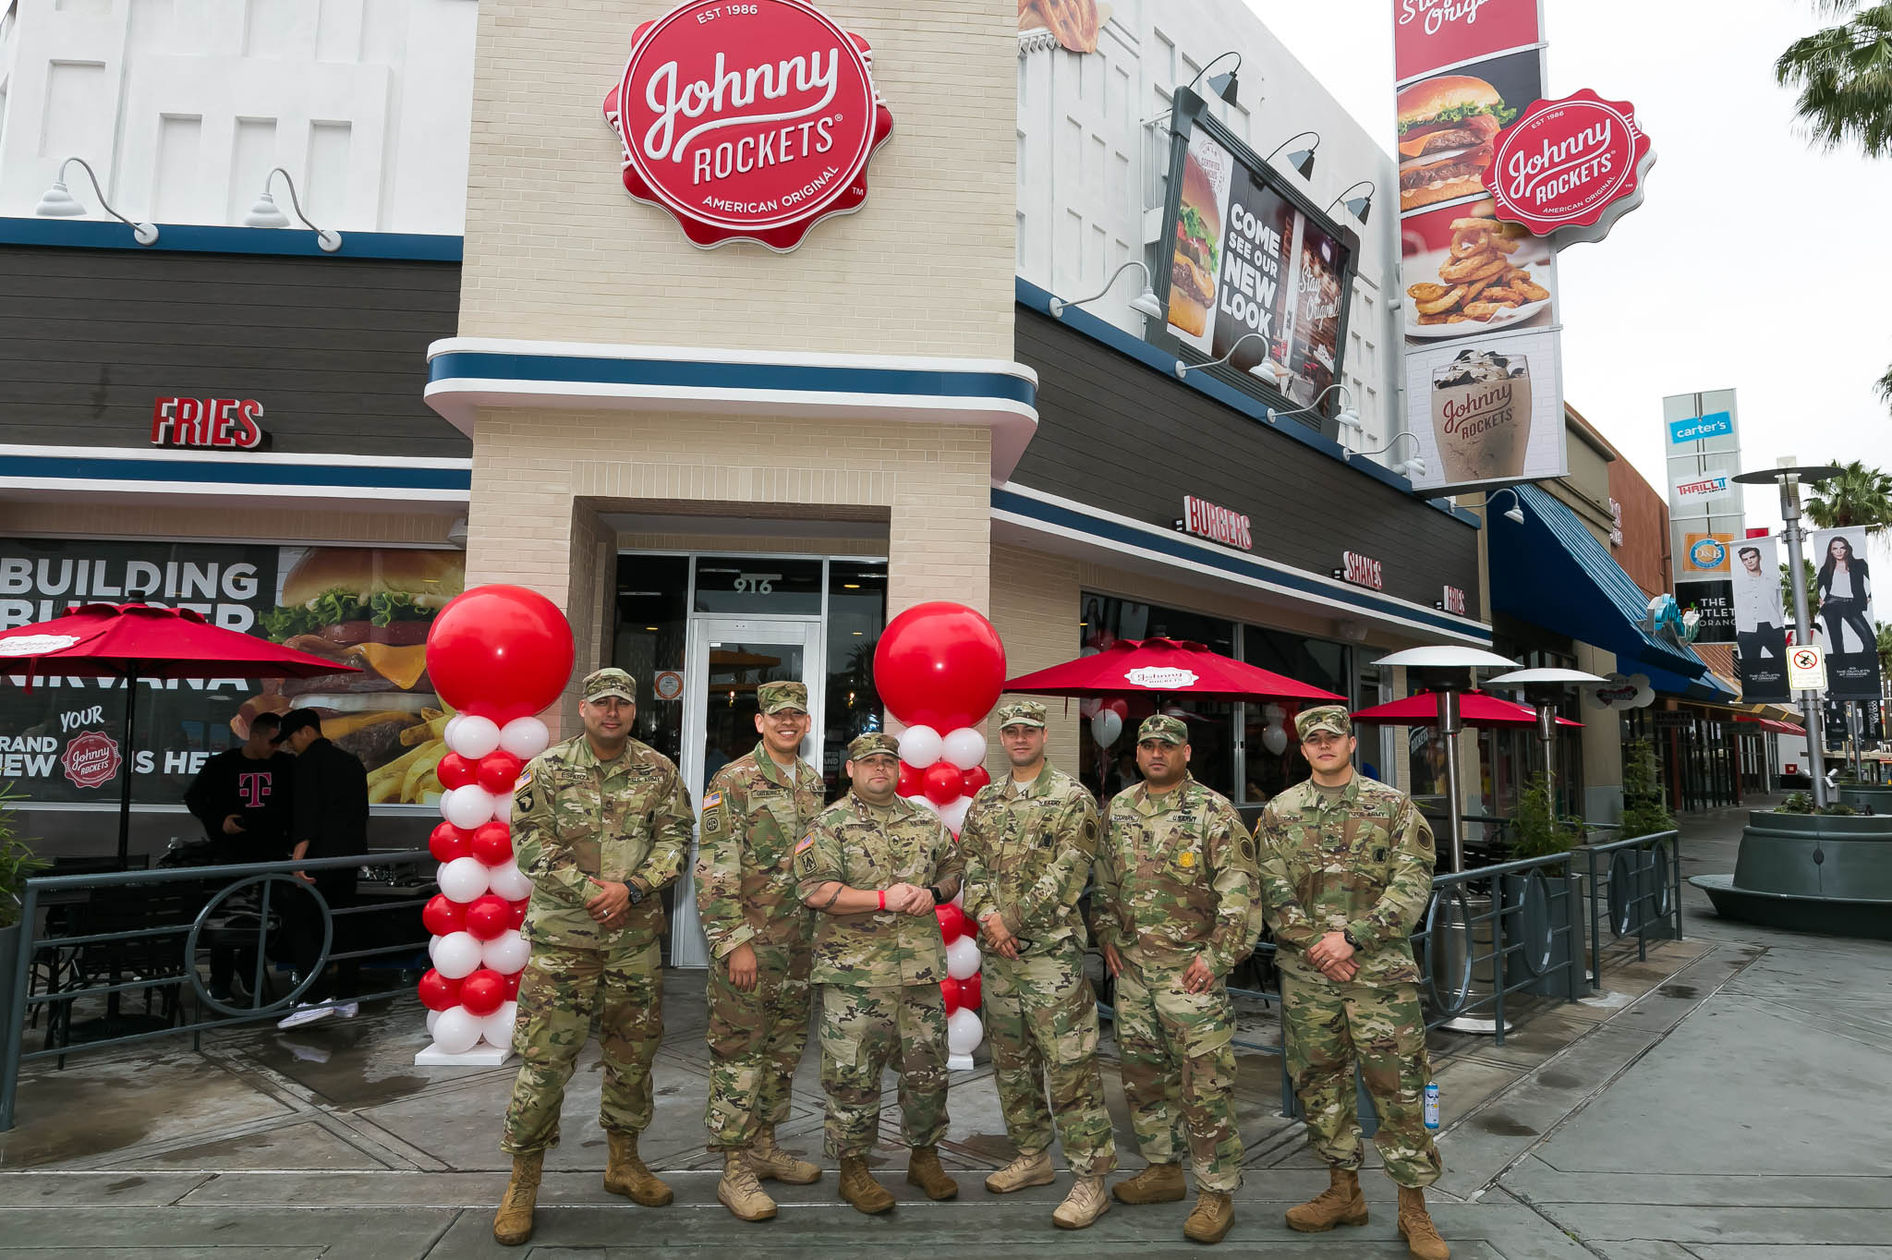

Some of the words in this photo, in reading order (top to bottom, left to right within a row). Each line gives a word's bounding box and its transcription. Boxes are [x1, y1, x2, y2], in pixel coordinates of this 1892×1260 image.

[697, 8, 721, 24] EST
[726, 4, 758, 16] 1986
[643, 48, 839, 163] Johnny
[1531, 118, 1545, 129] EST
[1546, 111, 1565, 121] 1986
[693, 116, 834, 186] ROCKETS
[1508, 118, 1611, 199] Johnny
[702, 195, 778, 214] AMERICAN
[781, 165, 840, 207] ORIGINAL
[1536, 153, 1612, 206] ROCKETS
[1543, 201, 1584, 214] AMERICAN
[1584, 175, 1617, 204] ORIGINAL
[1231, 203, 1280, 259] COME
[1228, 231, 1252, 260] SEE
[1254, 250, 1278, 279] OUR
[1224, 250, 1277, 309] NEW
[1299, 263, 1321, 301] Stay
[1221, 284, 1273, 339] LOOK
[150, 396, 264, 448] FRIES
[1443, 384, 1512, 434] Johnny
[1462, 408, 1513, 440] ROCKETS
[1676, 420, 1727, 438] carter's
[1184, 496, 1252, 550] BURGERS
[0, 557, 259, 600] BUILDING
[733, 578, 773, 595] 916
[1344, 551, 1382, 591] SHAKES
[1682, 607, 1736, 618] UTLET
[1700, 597, 1726, 607] THE
[61, 705, 105, 732] YOUR
[71, 747, 110, 771] Johnny
[81, 761, 109, 775] ROCKETS
[131, 750, 155, 774] S
[164, 751, 222, 774] HE
